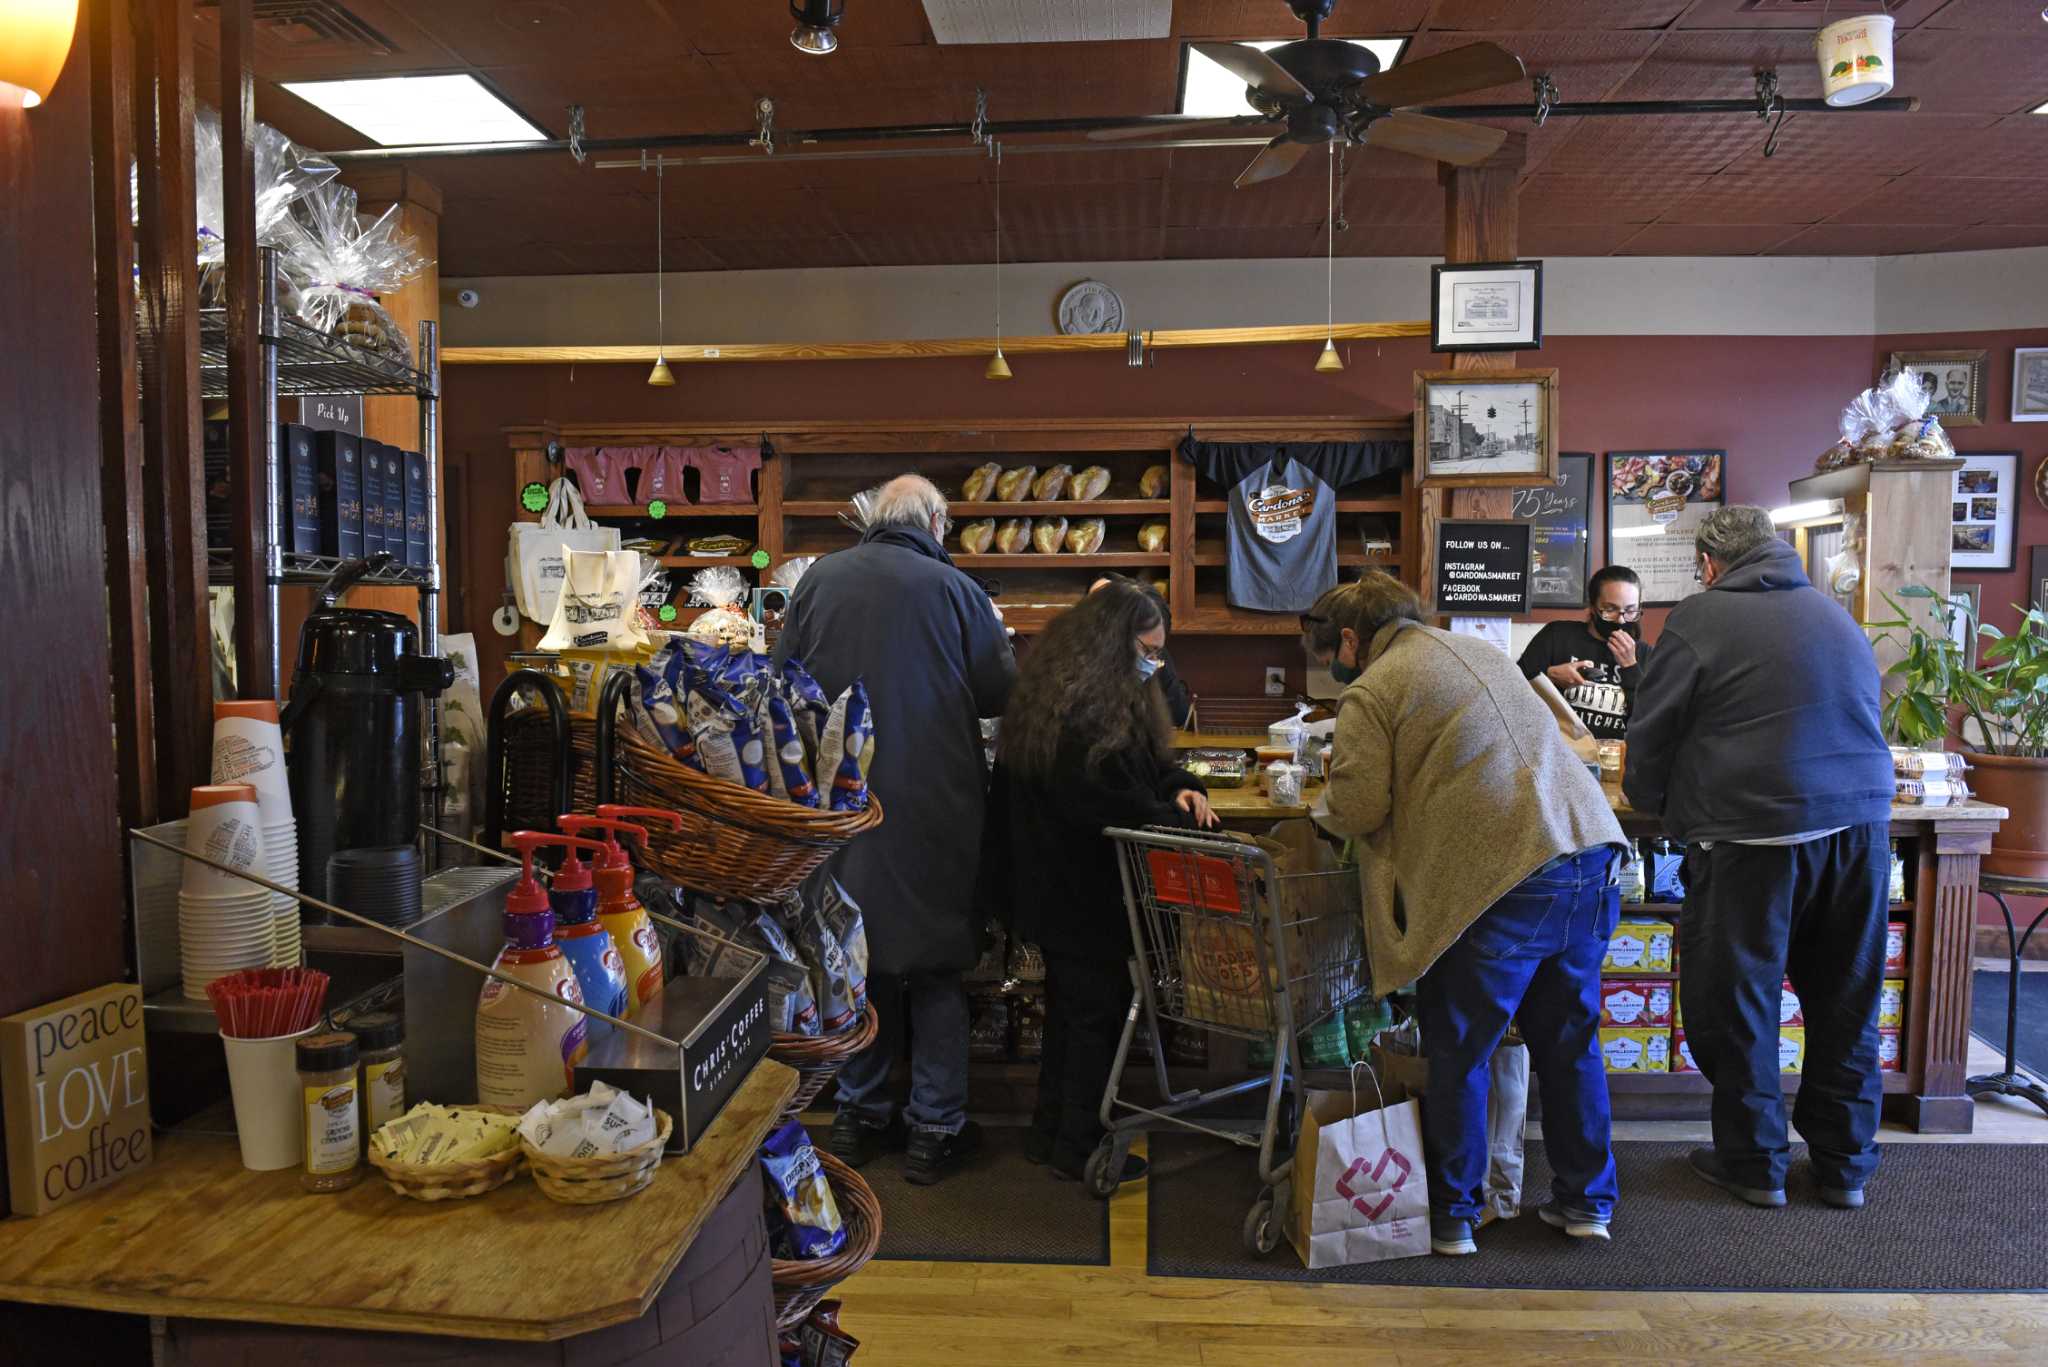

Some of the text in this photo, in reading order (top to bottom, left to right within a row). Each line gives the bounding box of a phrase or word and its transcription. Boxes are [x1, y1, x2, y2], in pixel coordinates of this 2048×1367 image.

[317, 402, 349, 425] Pick Up
[1248, 491, 1311, 512] Cardona's
[1512, 487, 1545, 518] 75
[1257, 508, 1306, 523] MARKET
[1445, 540, 1475, 549] FOLLOW
[1477, 541, 1488, 549] US
[1444, 562, 1486, 571] INSTAGRAM
[1448, 571, 1521, 581] @CARDONASMARKET
[1442, 584, 1481, 593] FACEBOOK
[731, 998, 764, 1048] COFFEE
[34, 994, 141, 1077] peace
[35, 1047, 146, 1143] LOVE
[43, 1121, 147, 1201] coffee
